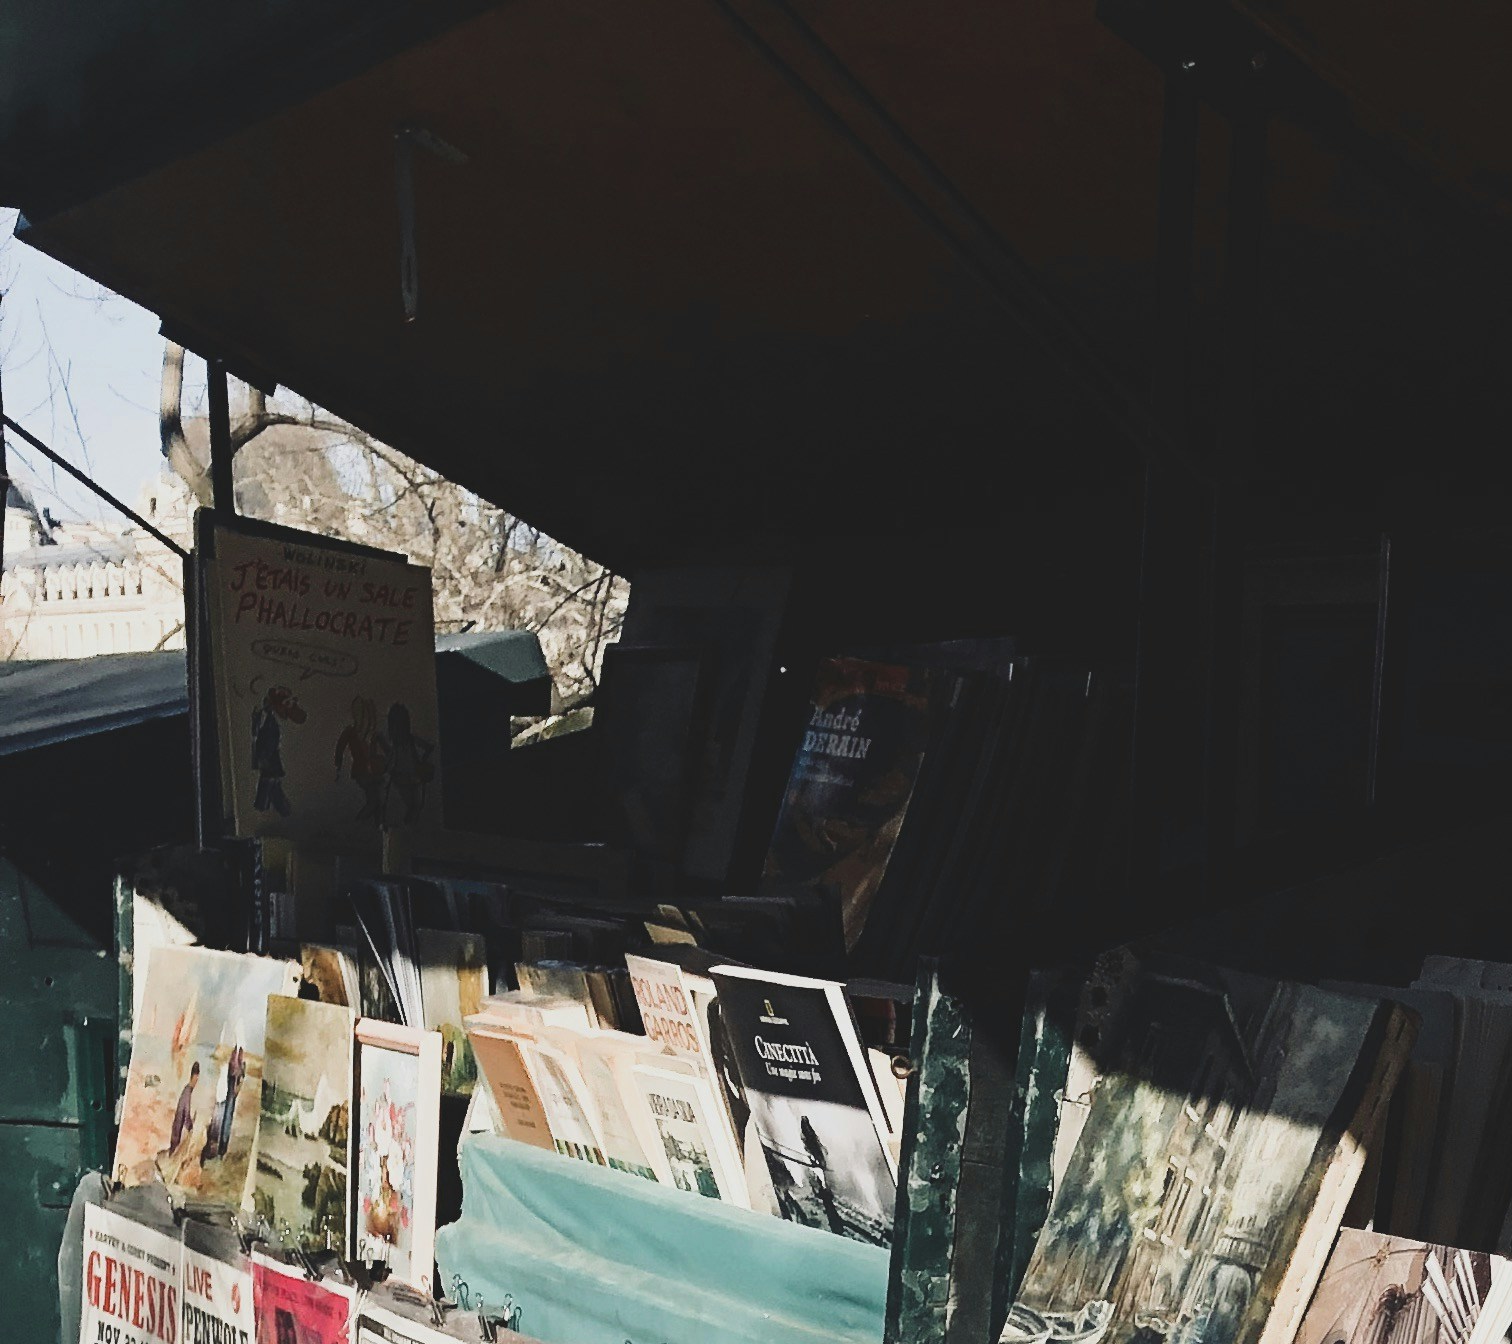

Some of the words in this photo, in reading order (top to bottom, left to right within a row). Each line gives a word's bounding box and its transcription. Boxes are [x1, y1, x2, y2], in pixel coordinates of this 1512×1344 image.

[323, 576, 350, 600] UN
[360, 580, 418, 608] SALE
[235, 591, 414, 646] PHALLOCRATE
[808, 706, 861, 733] André
[803, 730, 872, 760] DERAIN
[632, 976, 688, 1016] ROLAND
[186, 1262, 213, 1301] LIVE
